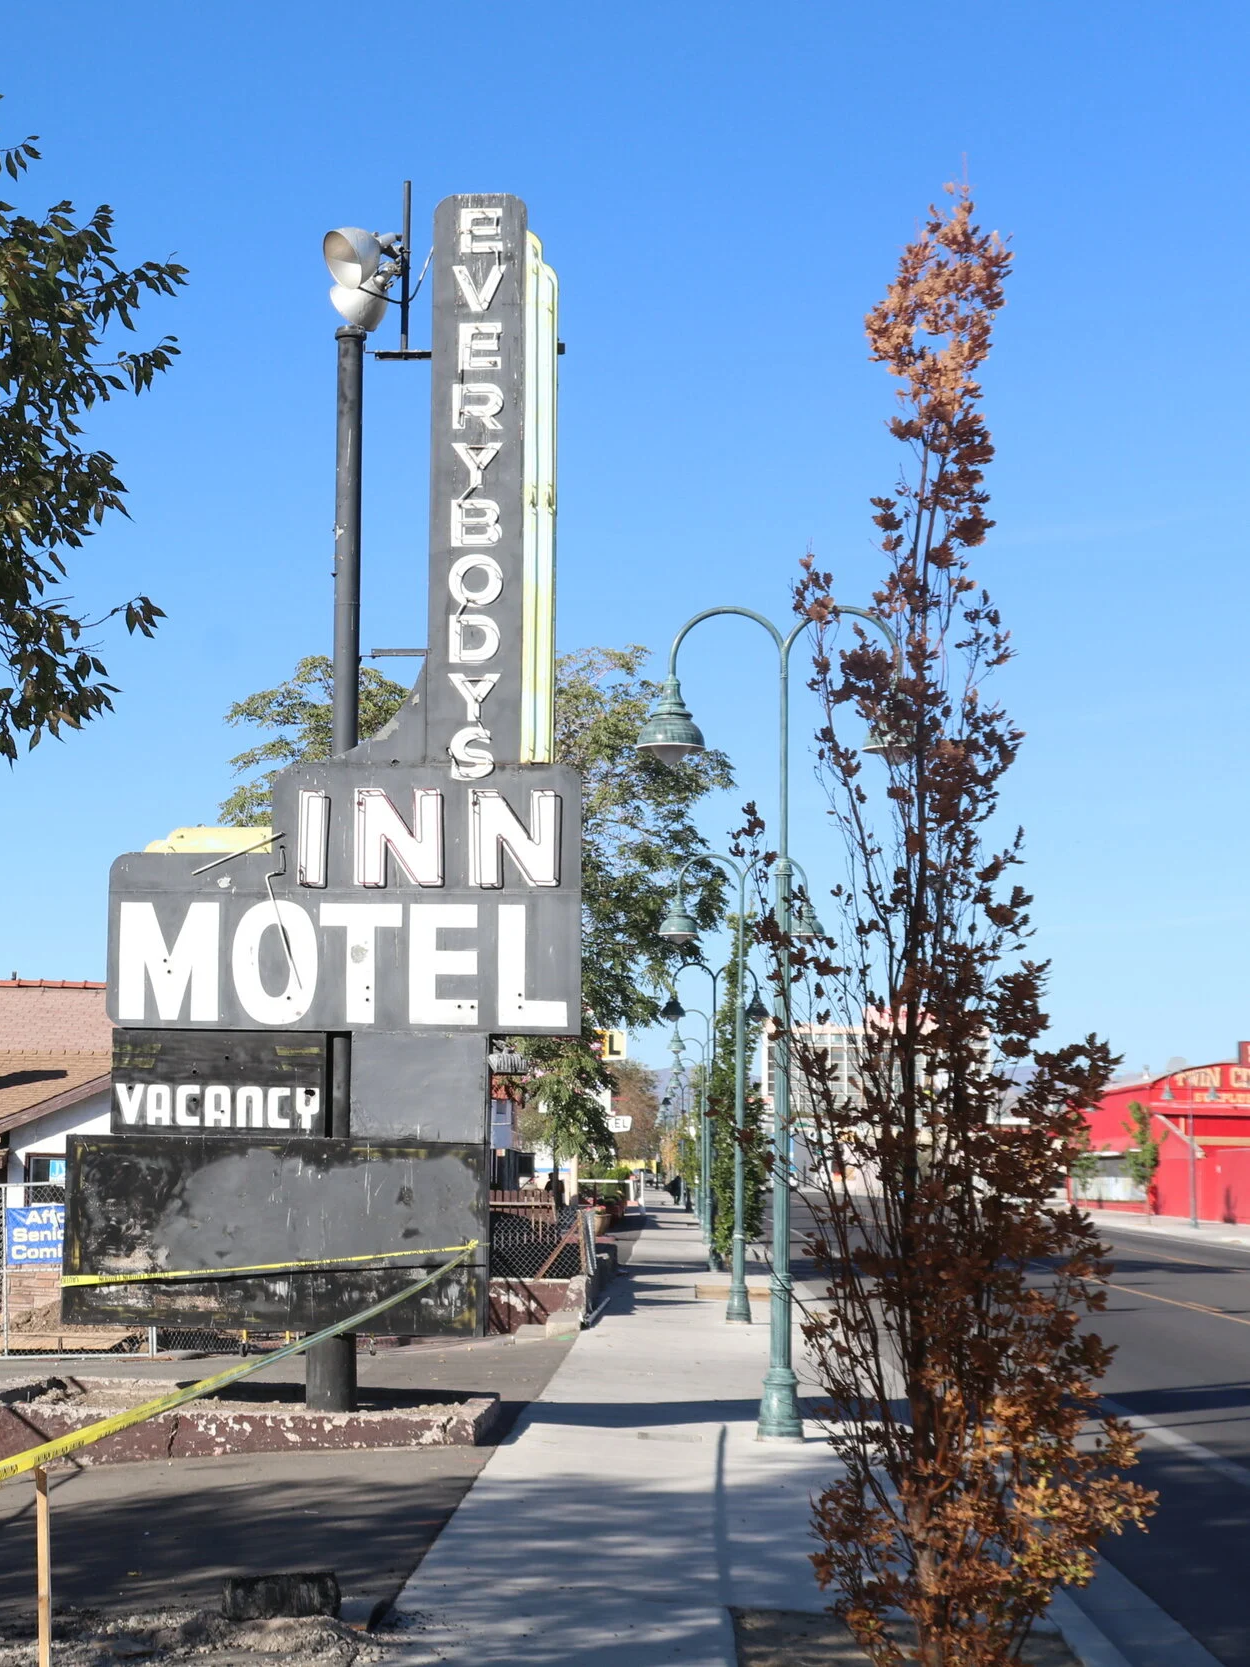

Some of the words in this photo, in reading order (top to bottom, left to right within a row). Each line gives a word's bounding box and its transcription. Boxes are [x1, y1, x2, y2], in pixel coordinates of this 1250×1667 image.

[448, 206, 508, 781] EVERYBODYS
[297, 788, 562, 888] INN
[117, 900, 569, 1028] MOTEL
[115, 1082, 320, 1130] VACANCY
